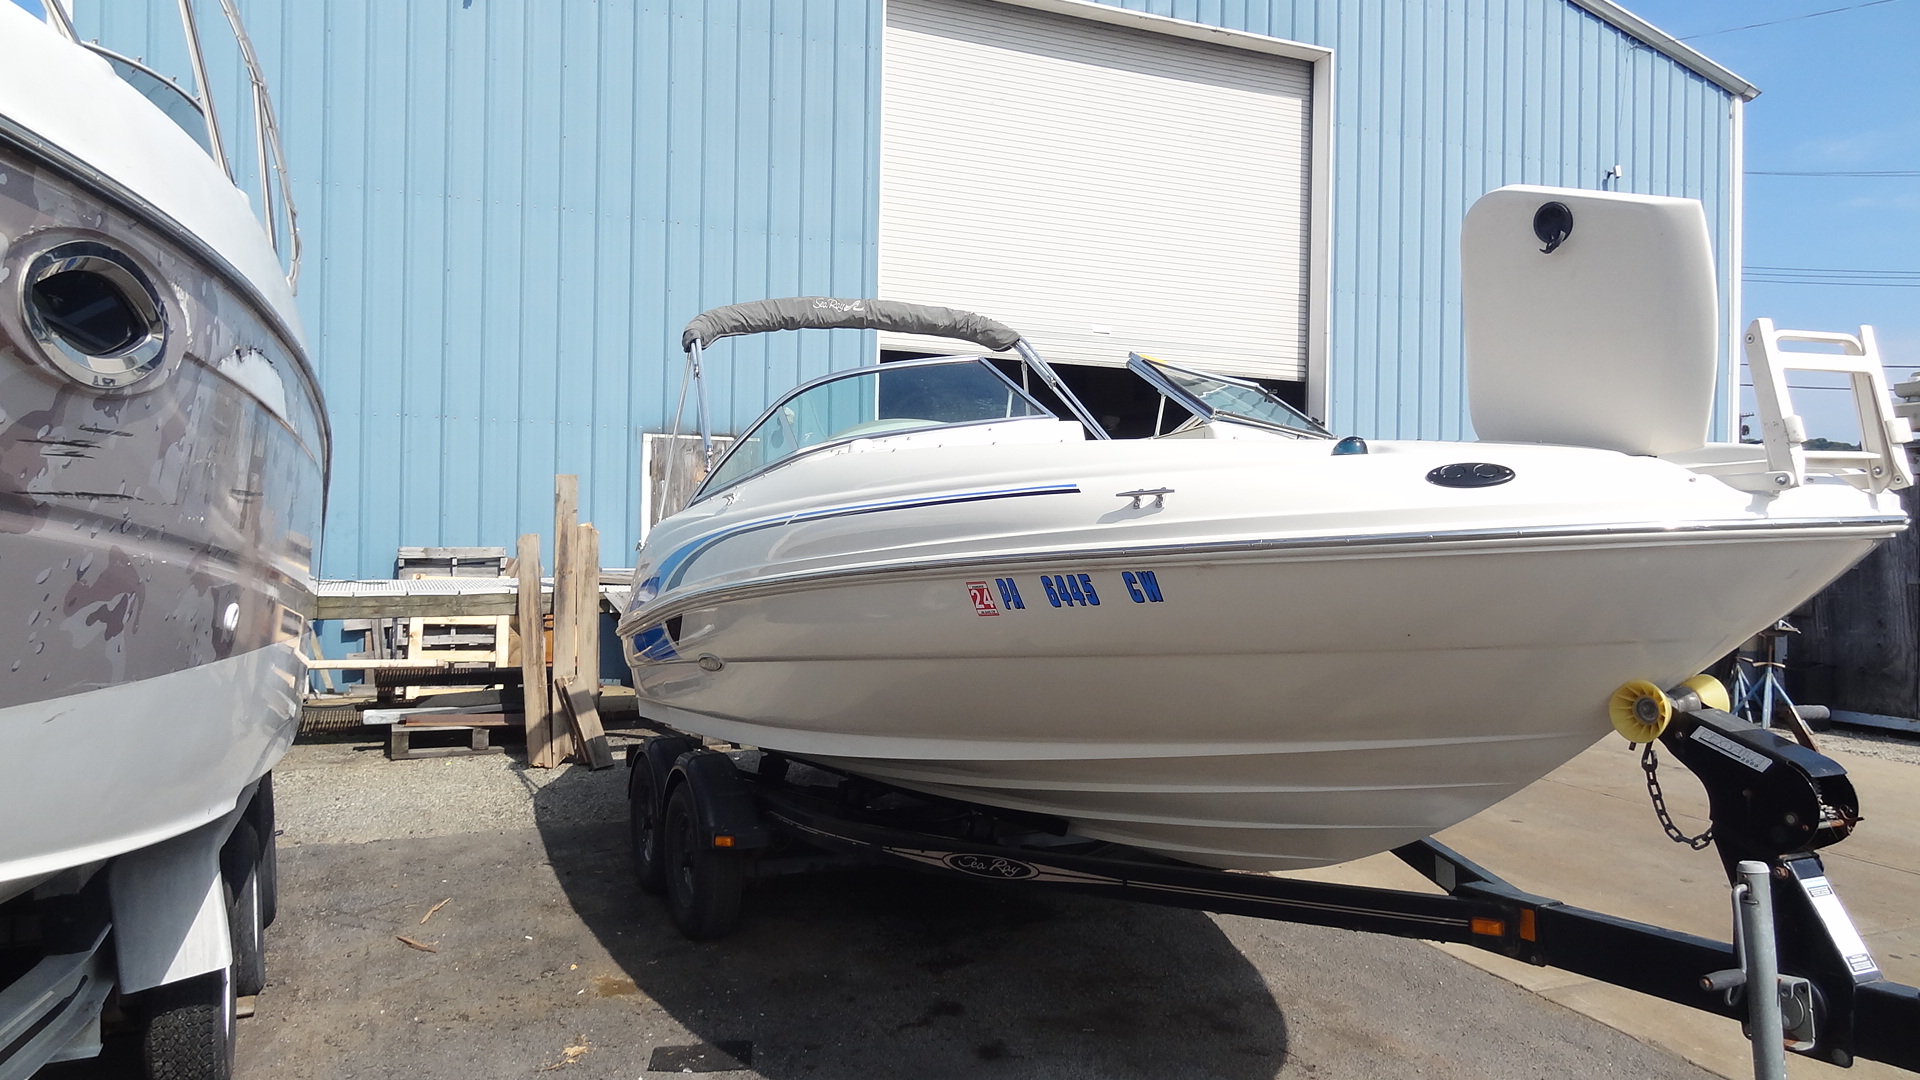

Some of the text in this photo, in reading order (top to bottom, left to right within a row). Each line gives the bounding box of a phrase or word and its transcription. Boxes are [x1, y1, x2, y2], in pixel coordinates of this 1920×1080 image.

[813, 298, 845, 312] Sea Ray
[970, 588, 994, 609] 24
[995, 570, 1164, 610] PA 6445 CW
[958, 856, 1021, 877] Sea Ray
